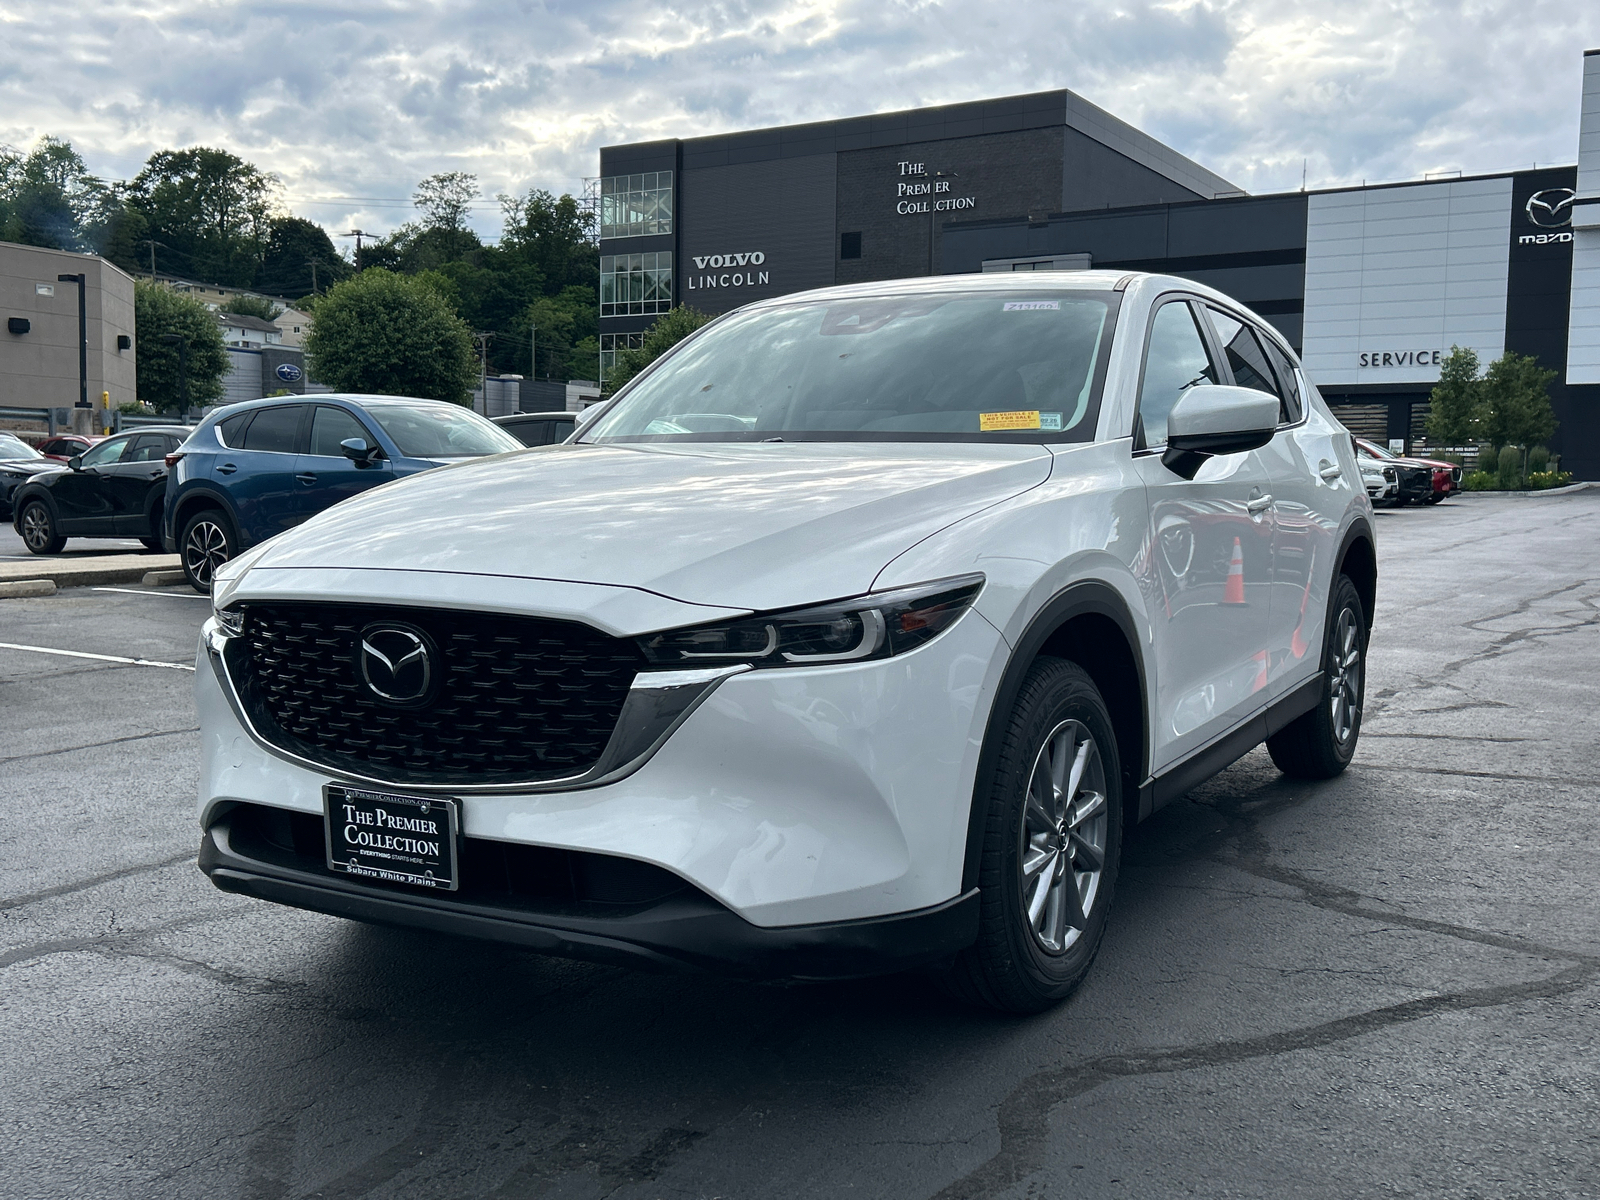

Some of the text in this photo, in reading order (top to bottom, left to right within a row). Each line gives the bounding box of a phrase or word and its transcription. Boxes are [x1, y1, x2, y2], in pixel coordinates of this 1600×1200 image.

[897, 161, 925, 176] THE
[897, 181, 950, 197] PREMER
[692, 251, 766, 270] VOLVO
[688, 271, 770, 290] LINCOLN
[1359, 350, 1441, 367] SERVICE
[342, 804, 439, 834] THE PREMIER
[344, 824, 440, 857] COLLECTION
[359, 849, 392, 859] EVERYTHING
[346, 865, 437, 887] Subaru White Plains
